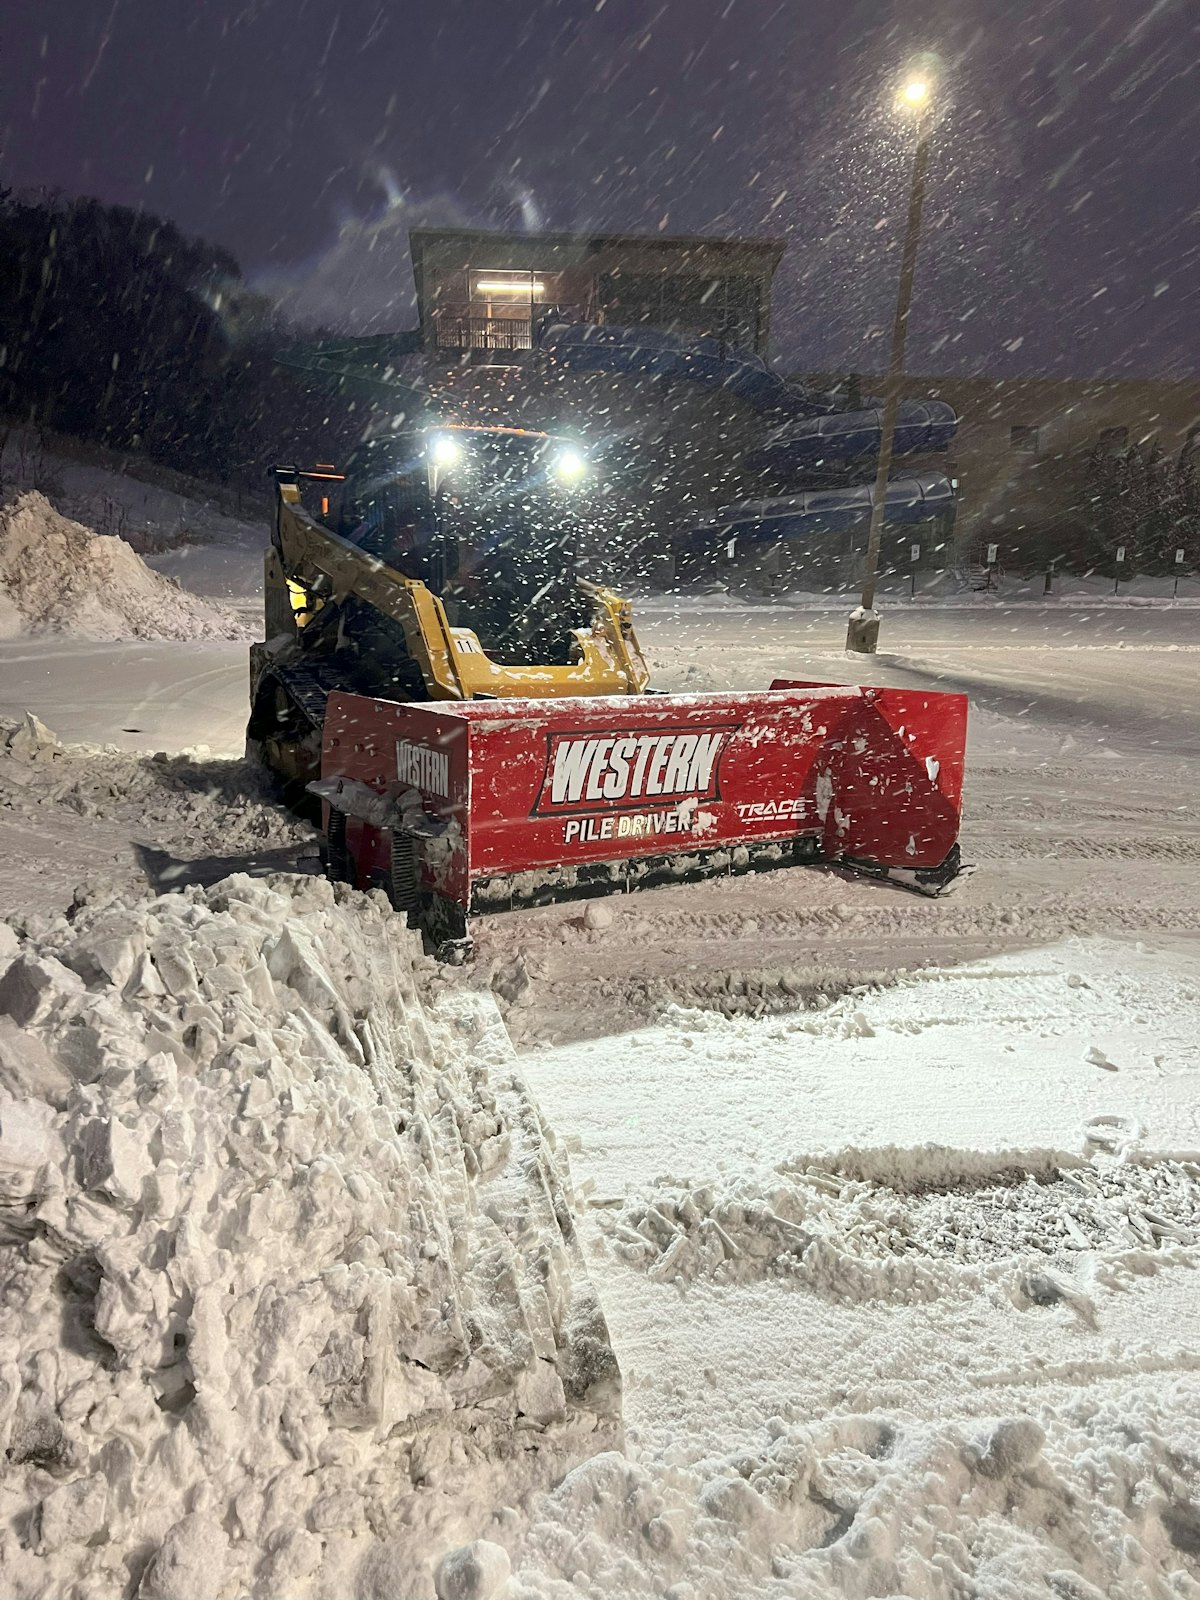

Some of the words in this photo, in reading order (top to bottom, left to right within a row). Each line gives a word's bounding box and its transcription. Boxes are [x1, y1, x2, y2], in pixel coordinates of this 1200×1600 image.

[457, 640, 473, 653] 11
[396, 740, 449, 799] WESTERN
[552, 734, 723, 803] WESTERN
[737, 799, 806, 818] TRACE
[564, 817, 614, 844] PILE
[617, 810, 691, 838] DRIVER
